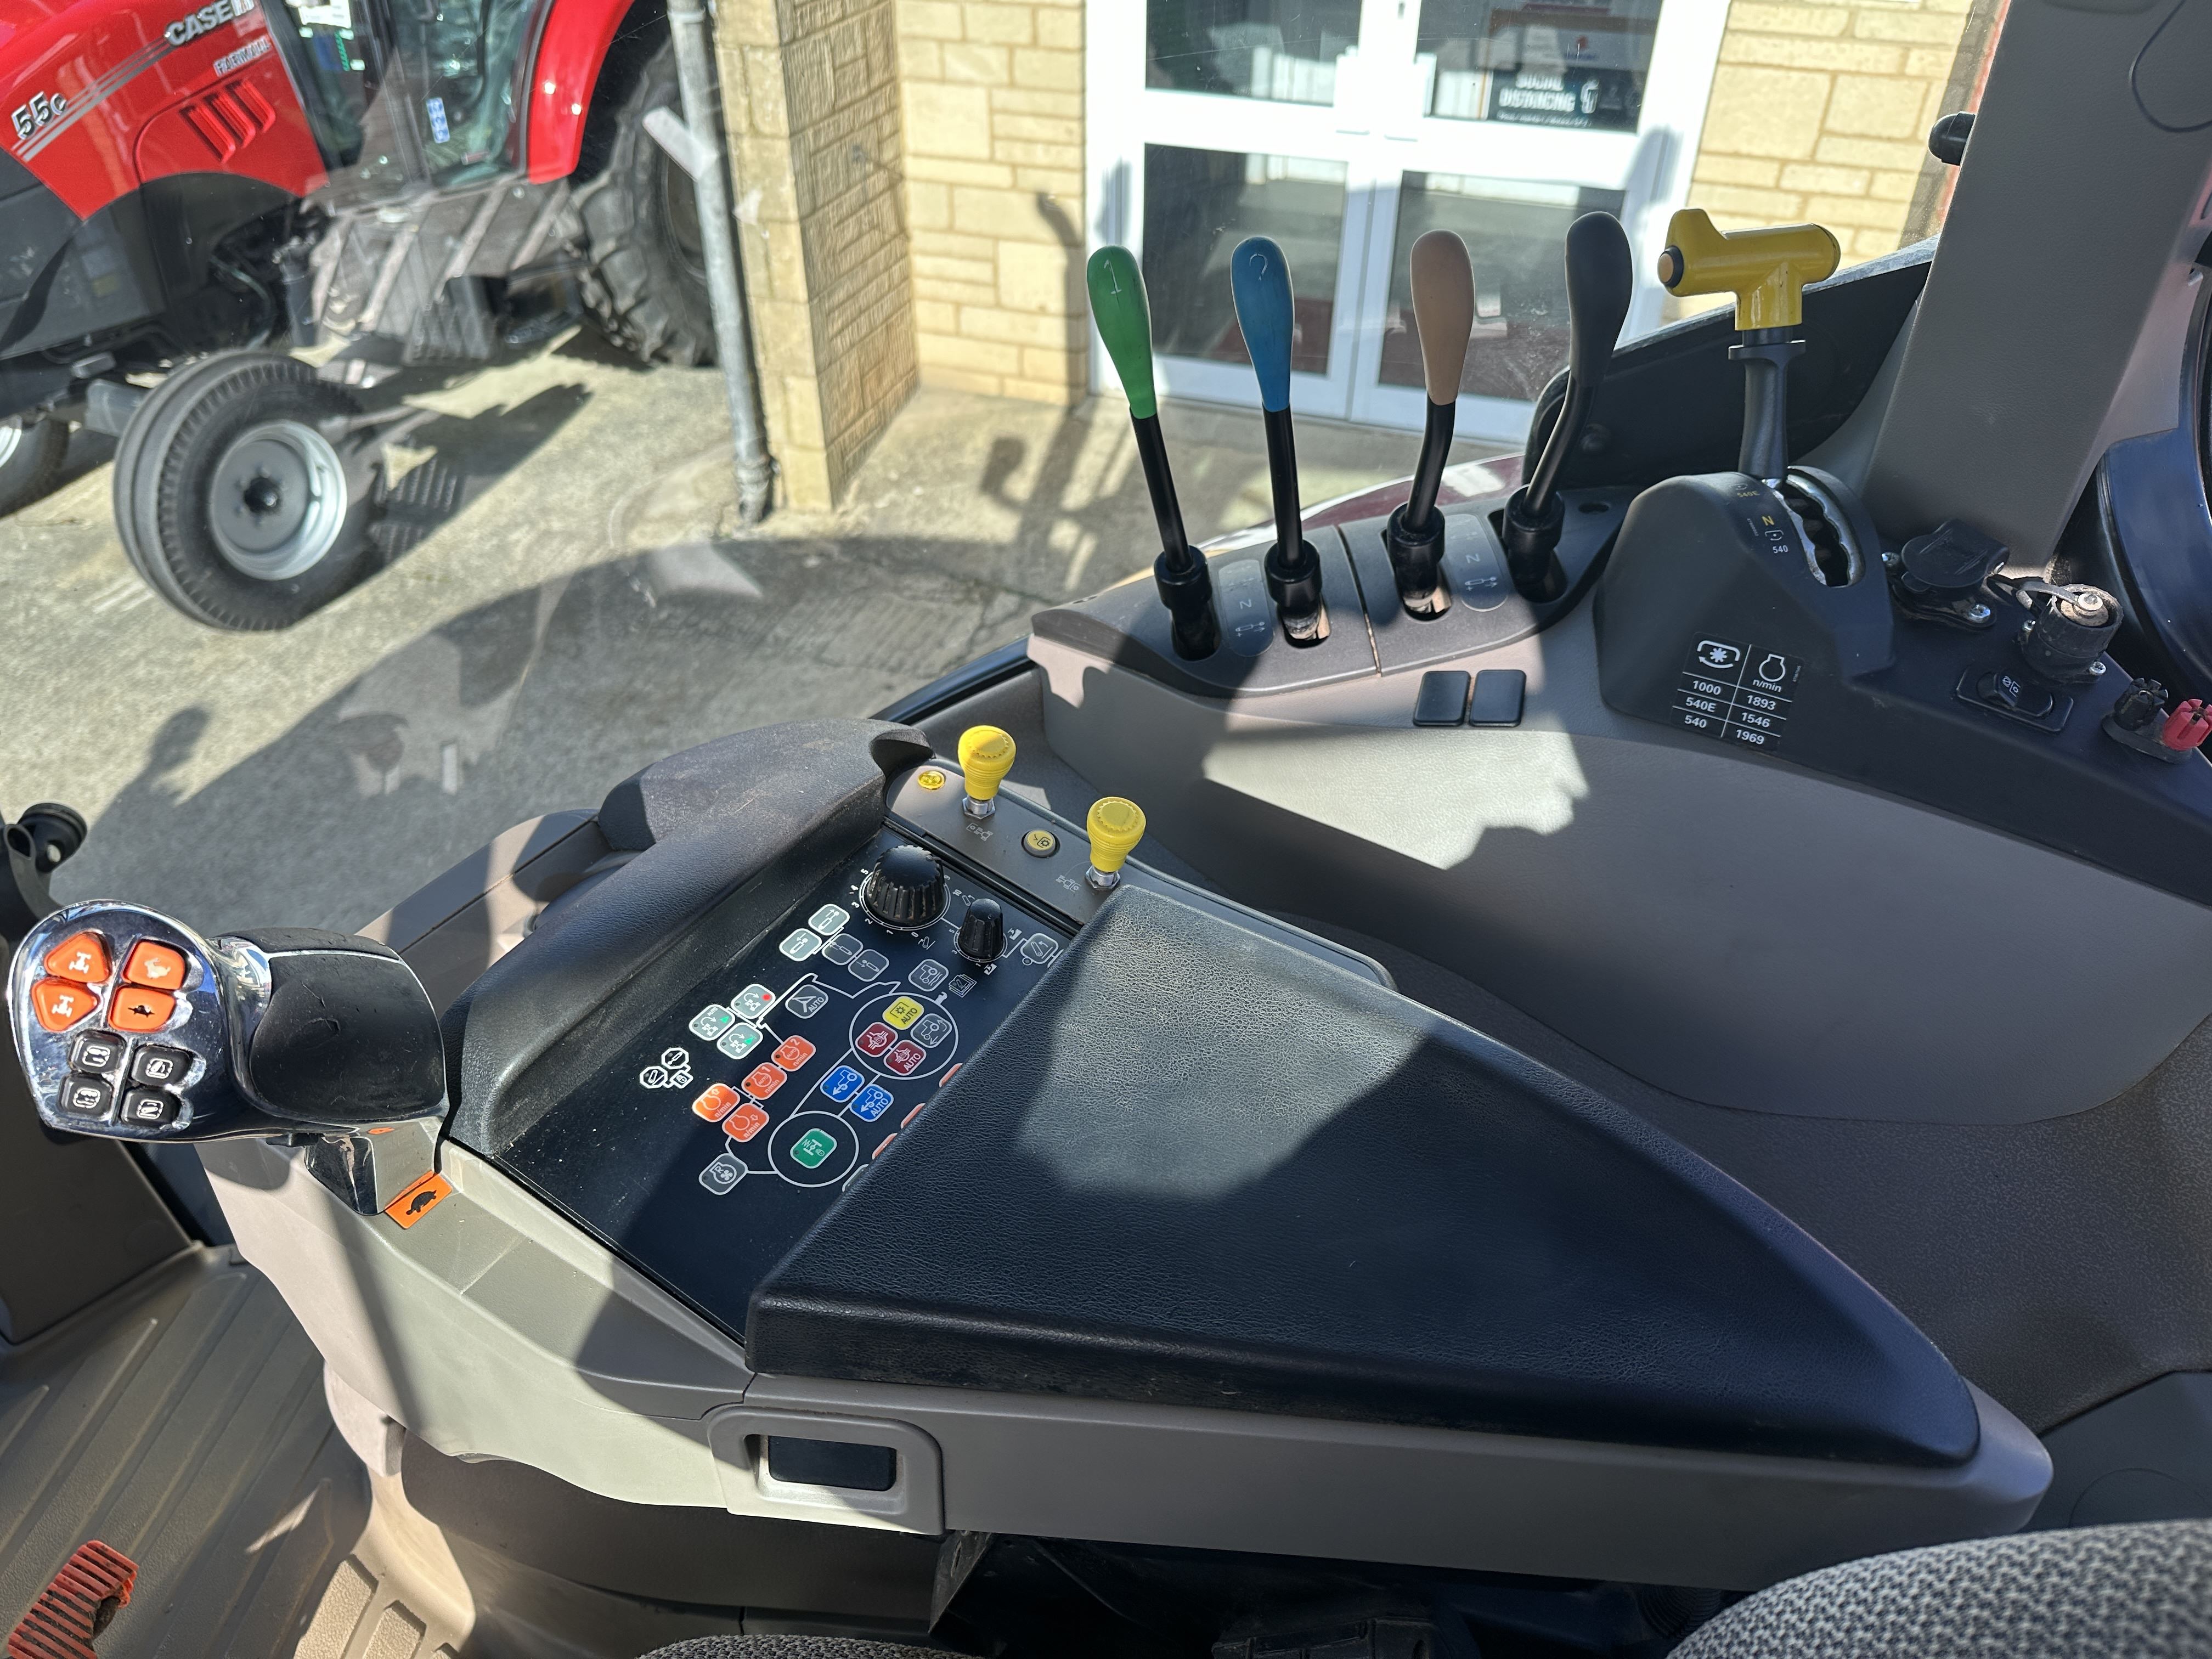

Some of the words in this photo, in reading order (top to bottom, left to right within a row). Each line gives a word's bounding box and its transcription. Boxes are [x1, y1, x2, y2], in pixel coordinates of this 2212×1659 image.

[164, 0, 233, 46] CASE
[1762, 515, 1775, 526] N
[1773, 545, 1788, 554] 540
[1692, 680, 1722, 696] 1000
[1752, 679, 1782, 692] n/min
[1685, 697, 1717, 713] 540E
[1747, 695, 1776, 710] 1893
[1684, 715, 1707, 729] 540
[1741, 712, 1771, 728] 1546
[1735, 729, 1765, 745] 1969
[808, 996, 825, 1013] AUTO
[901, 1007, 918, 1024] AUTO
[904, 1053, 921, 1071] AUTO
[714, 1102, 732, 1118] n/min
[870, 1098, 889, 1117] AUTO
[743, 1121, 761, 1138] n/min
